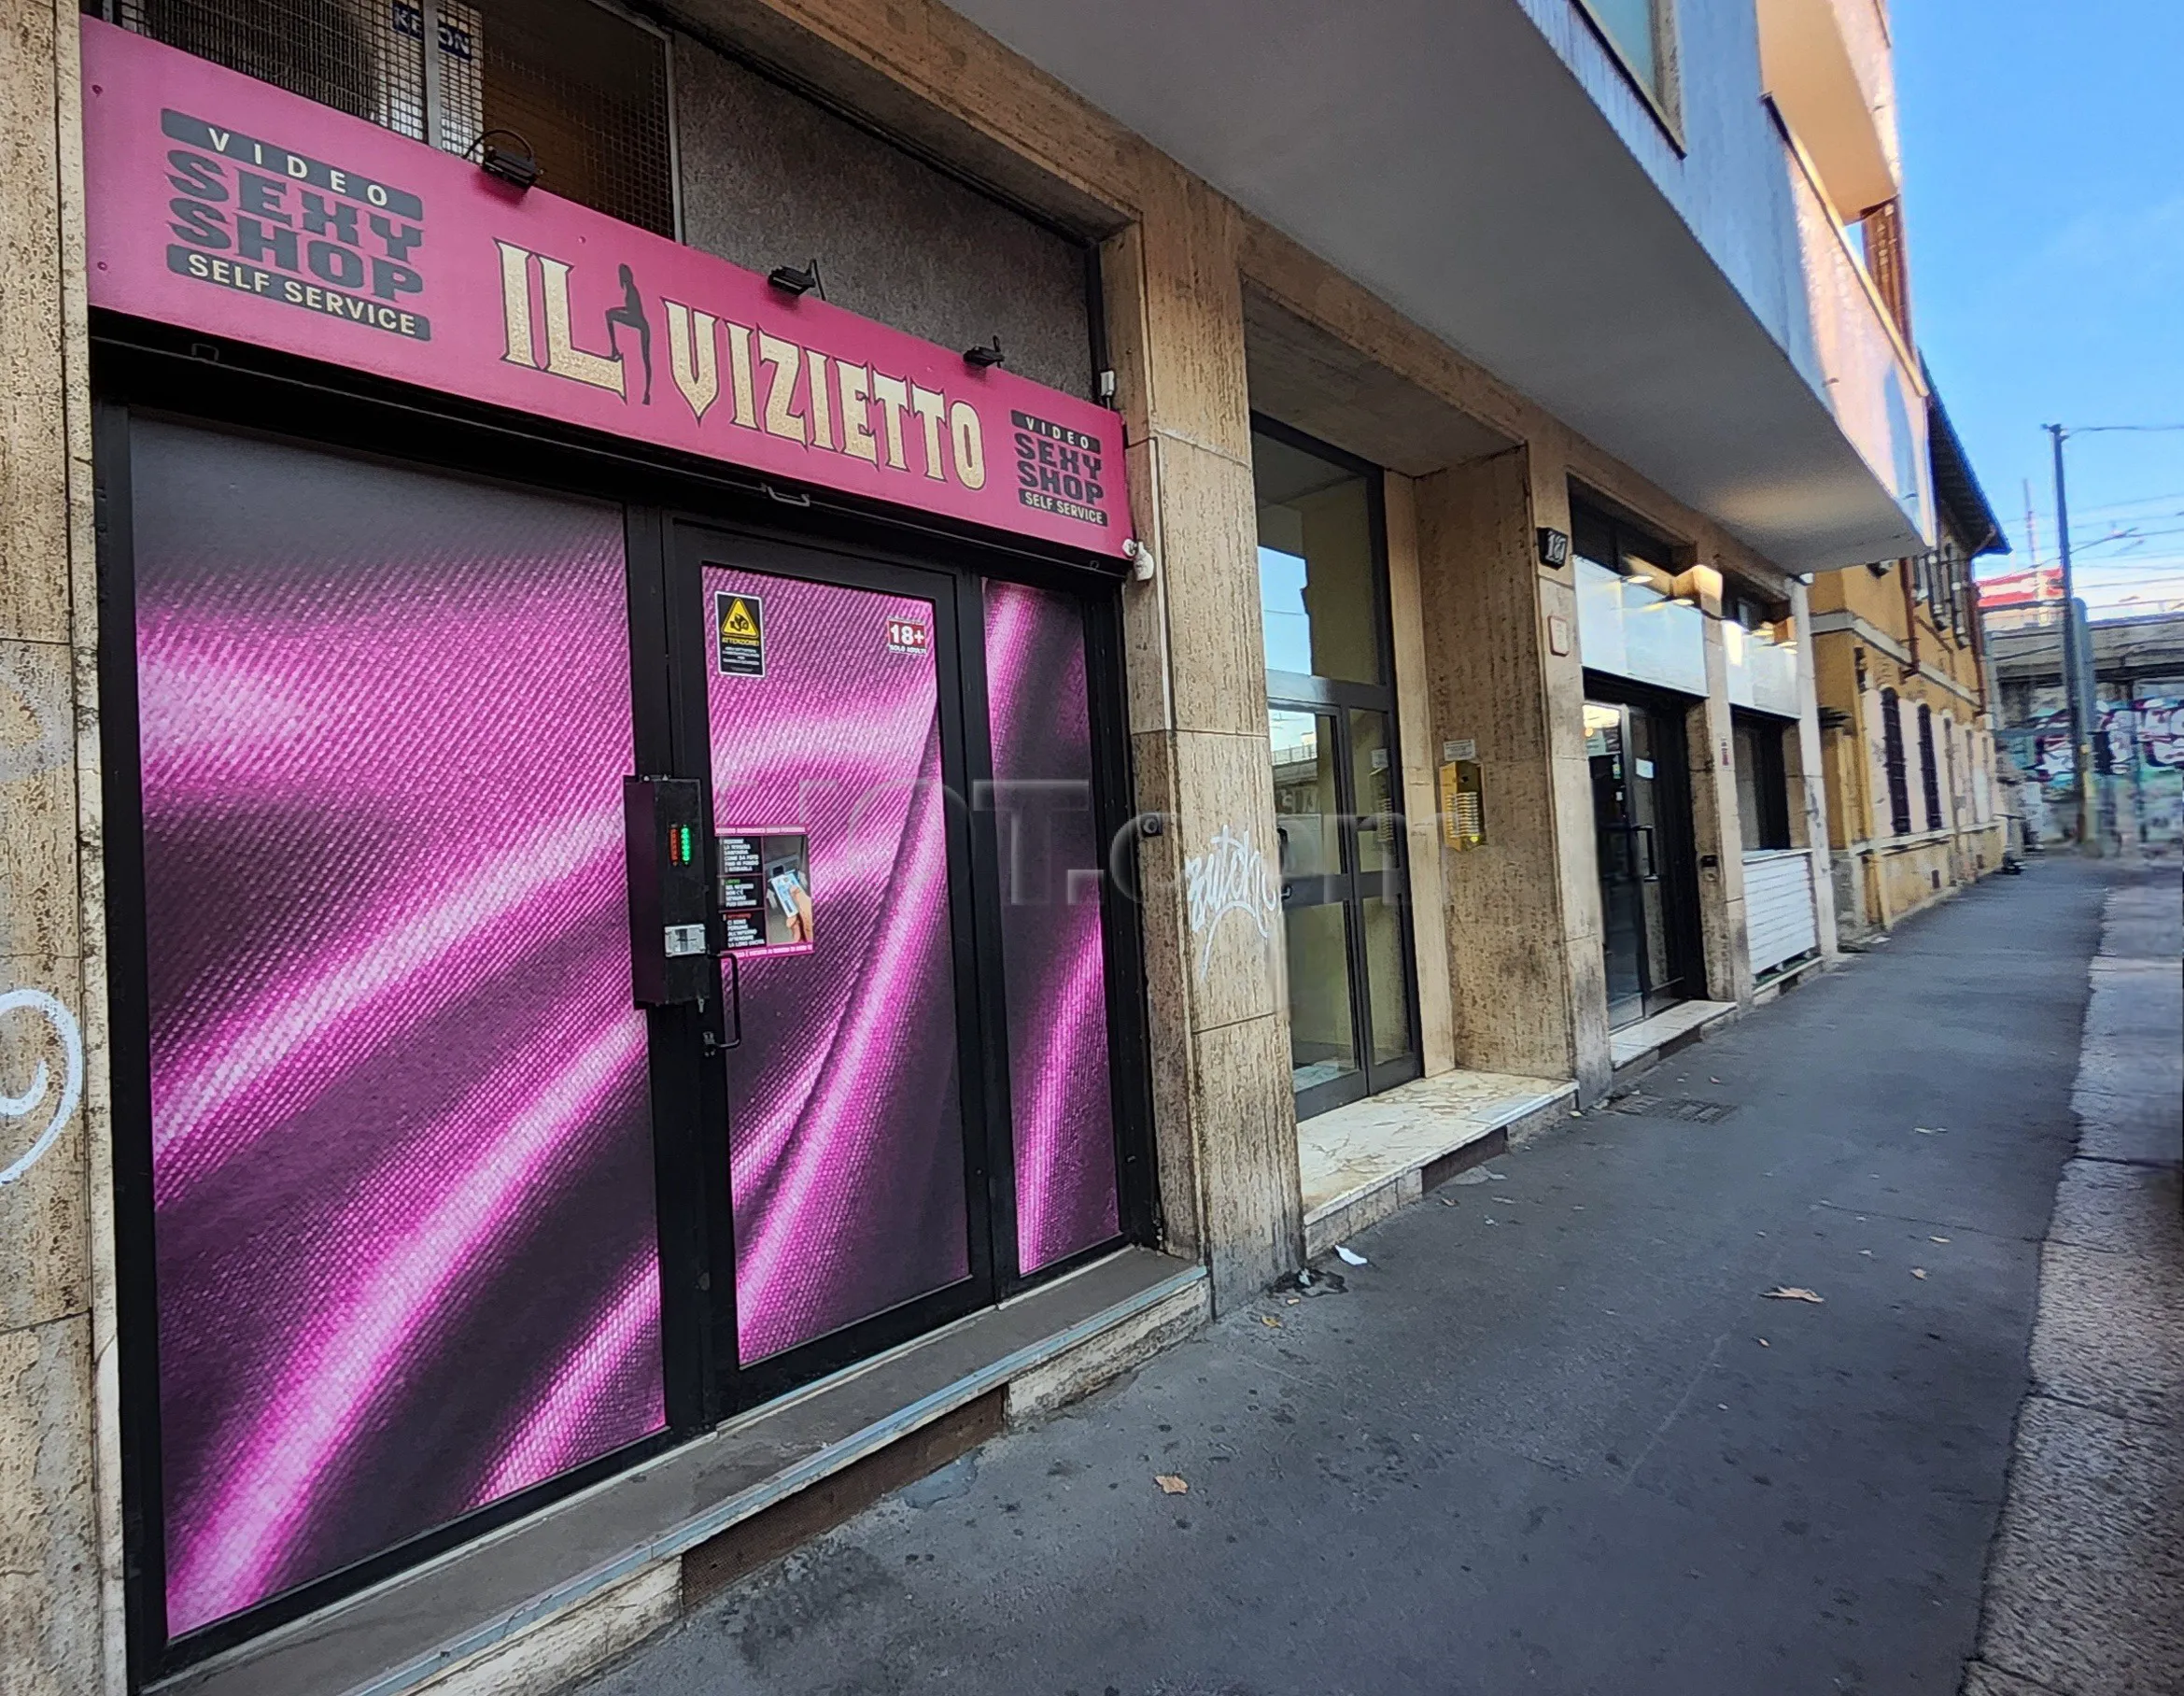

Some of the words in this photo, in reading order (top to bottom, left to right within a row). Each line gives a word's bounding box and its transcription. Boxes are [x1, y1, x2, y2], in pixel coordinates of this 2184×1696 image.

[207, 127, 387, 206] VIDEO
[165, 149, 424, 261] SEXY
[166, 197, 423, 303] SHOP
[189, 254, 270, 293] SELF
[284, 281, 416, 335] SERVICE
[493, 237, 627, 403] IL
[660, 297, 987, 491] VIZIETTO
[1014, 432, 1102, 480] SEXY
[1025, 417, 1089, 449] VIDEO
[1017, 460, 1104, 505] SHOP
[1025, 491, 1053, 510] SELF
[1056, 501, 1104, 524] SERVICE
[890, 624, 925, 645] 18+
